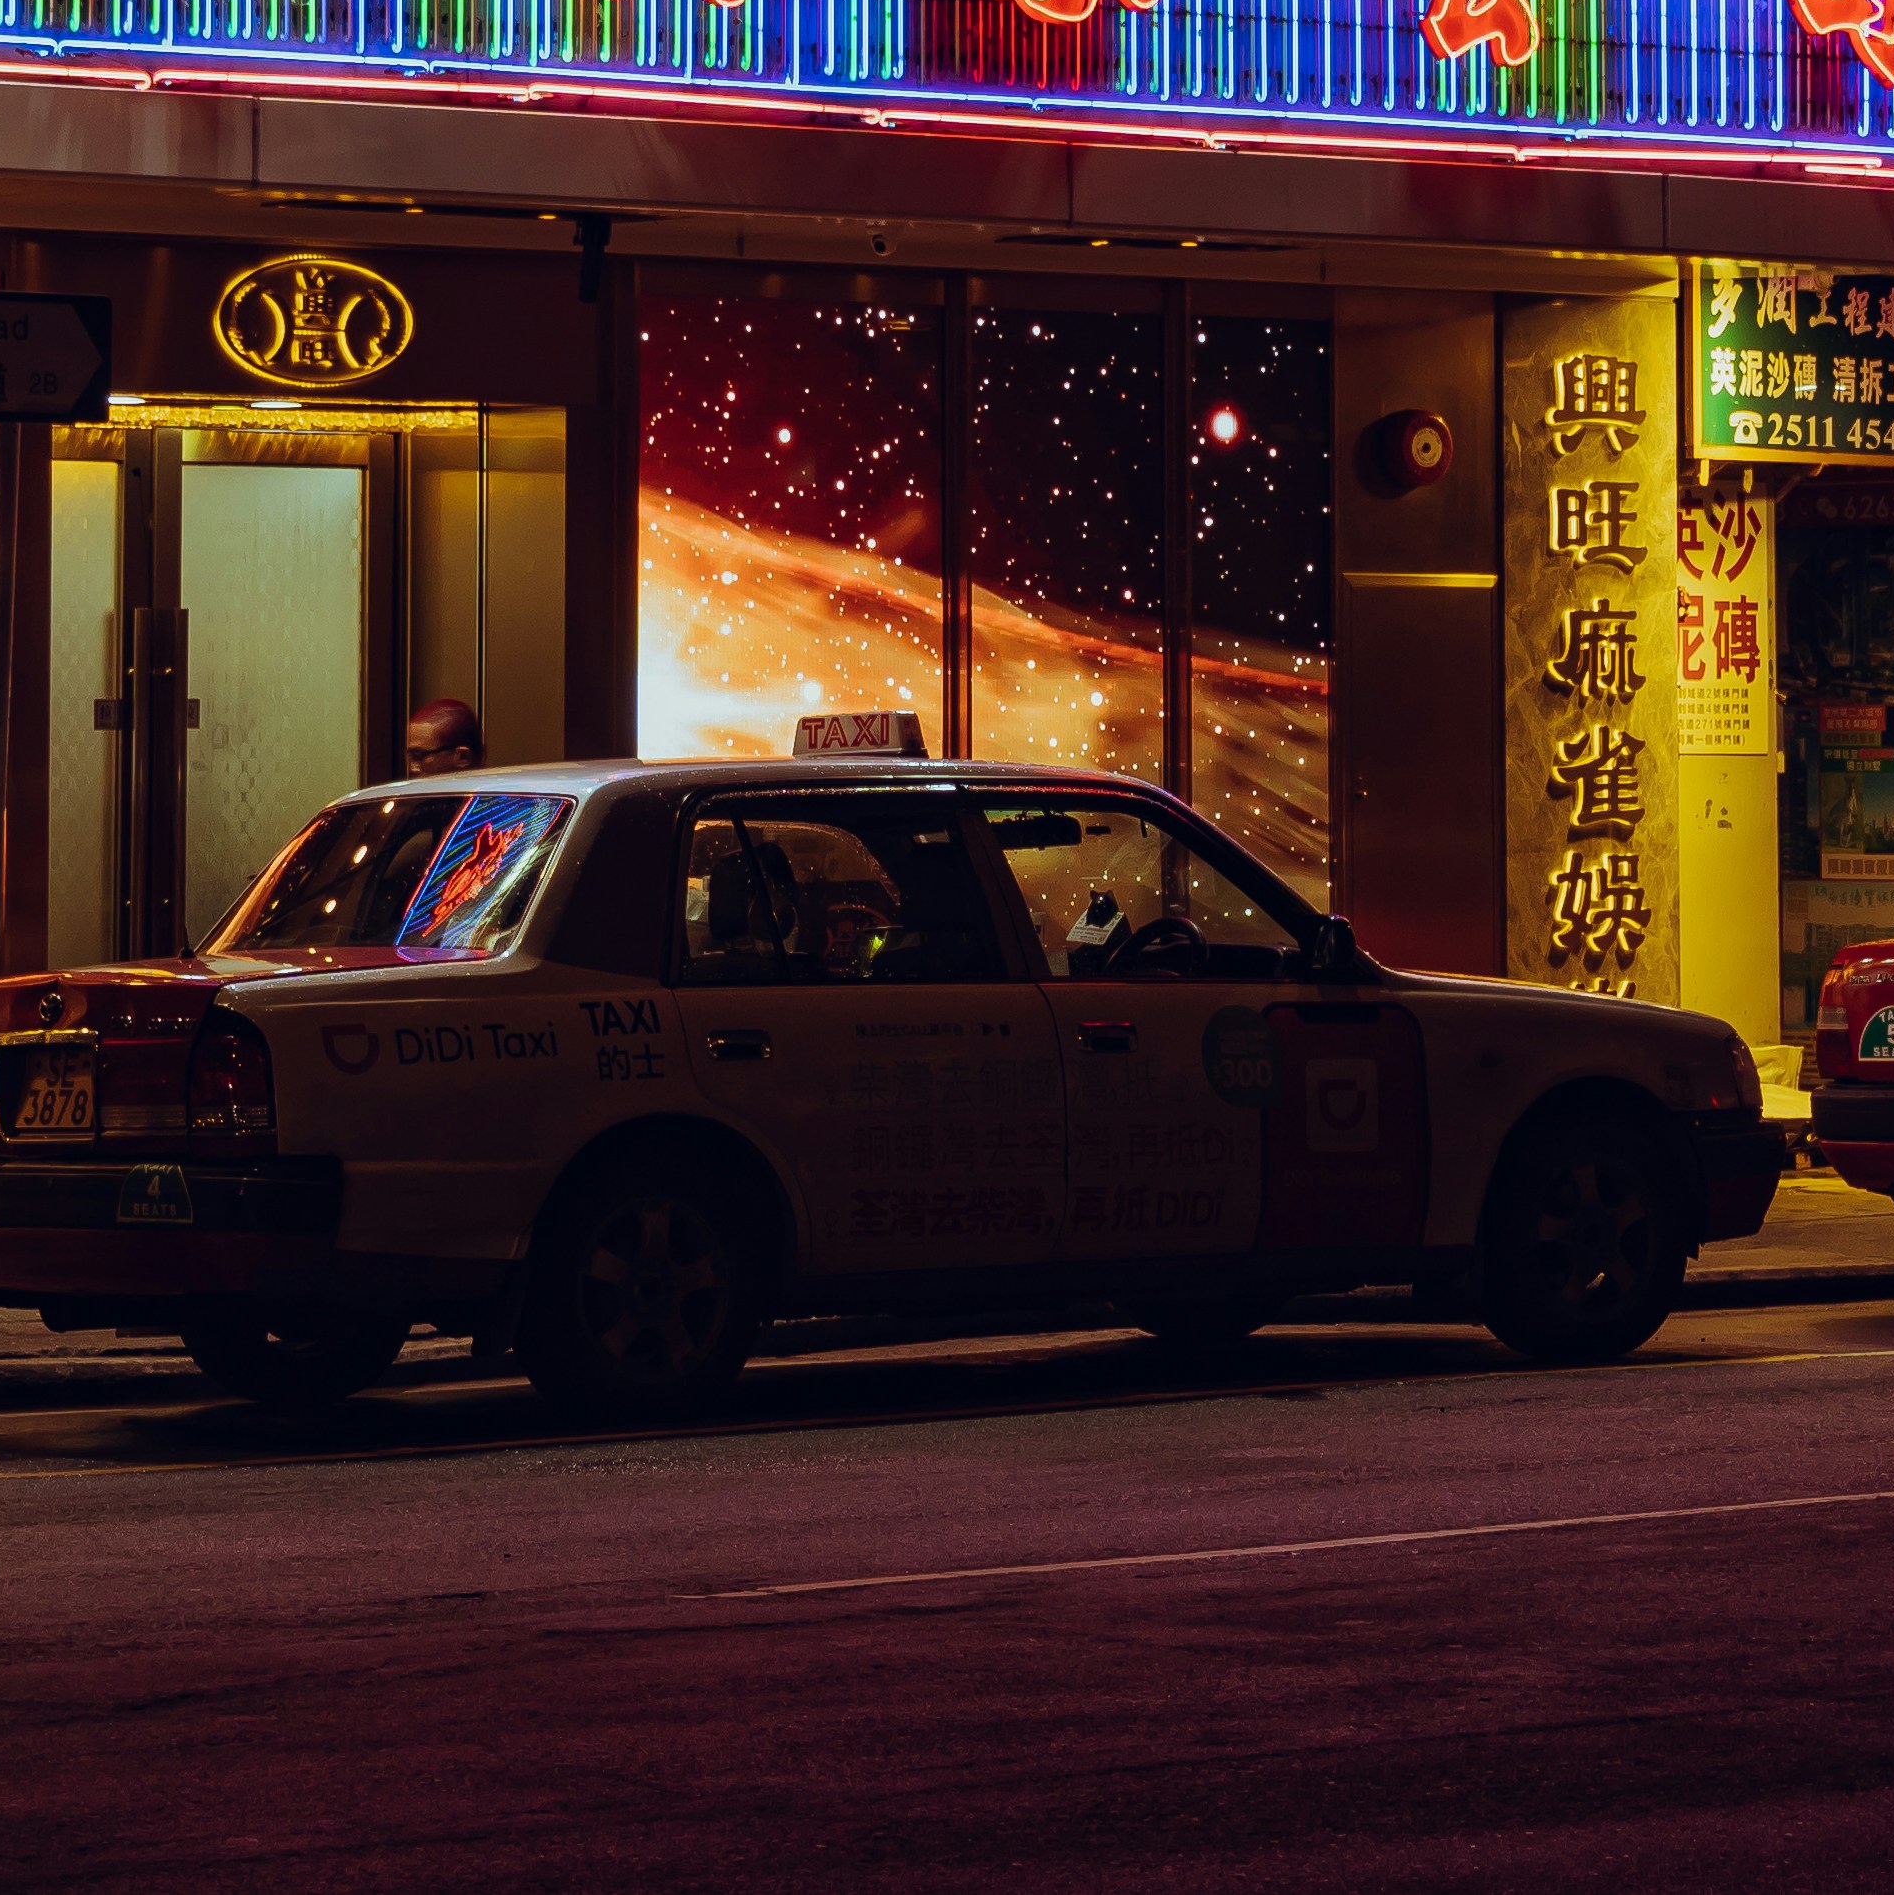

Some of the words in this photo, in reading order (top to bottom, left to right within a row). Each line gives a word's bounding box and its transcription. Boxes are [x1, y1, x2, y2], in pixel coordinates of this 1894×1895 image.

[30, 373, 59, 395] 2B
[1710, 346, 1817, 401] 英泥沙磚
[1767, 412, 1836, 447] 2511
[1545, 352, 1653, 998] 興旺麻雀娛
[802, 714, 890, 750] TAXI
[579, 999, 660, 1037] TAXI
[396, 1027, 474, 1065] DiDi
[482, 1021, 558, 1059] Taxi
[47, 1055, 76, 1089] SE
[597, 1043, 665, 1081] 的士
[24, 1089, 89, 1126] 3878
[147, 1175, 161, 1199] 4
[133, 1203, 178, 1217] SEATS
